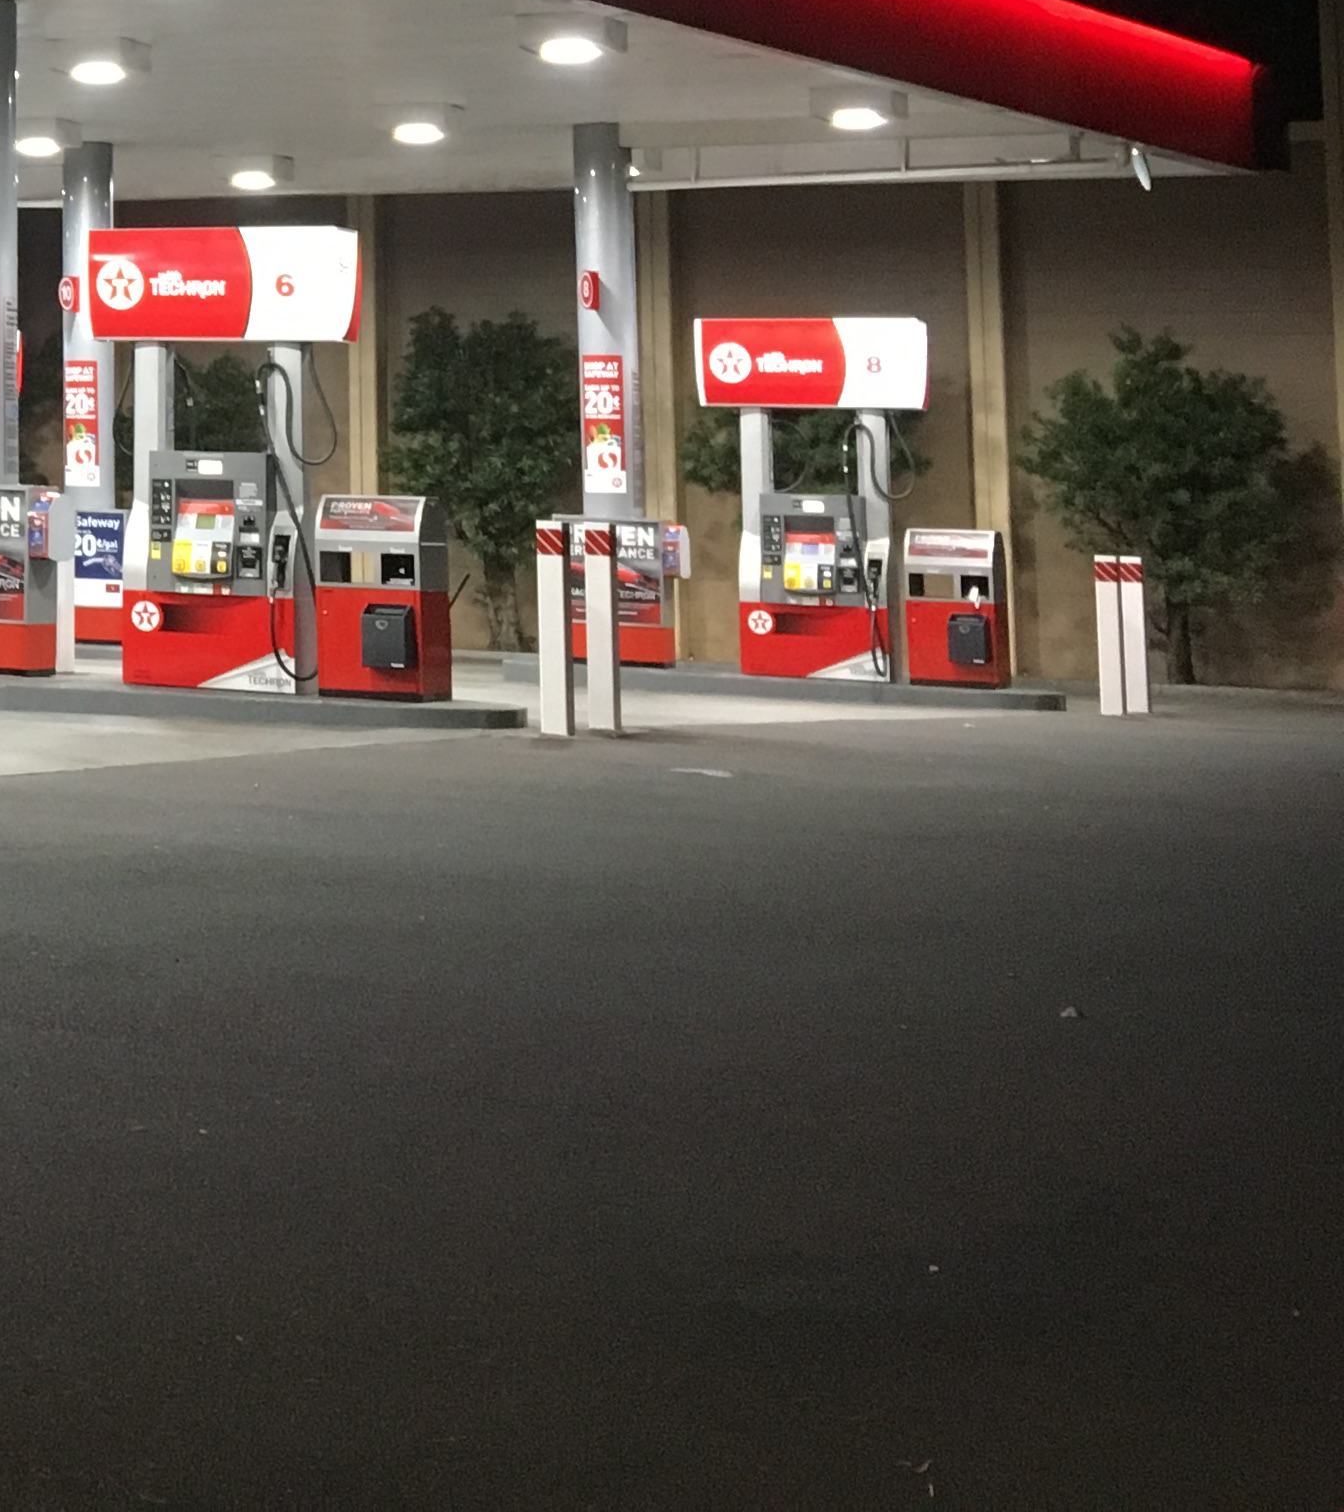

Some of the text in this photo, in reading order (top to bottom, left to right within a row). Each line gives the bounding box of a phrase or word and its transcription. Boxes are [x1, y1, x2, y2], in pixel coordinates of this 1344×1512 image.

[61, 286, 72, 301] 10
[150, 277, 226, 298] TECHRON
[275, 274, 294, 297] 6
[583, 281, 589, 297] 8
[866, 356, 882, 373] 8
